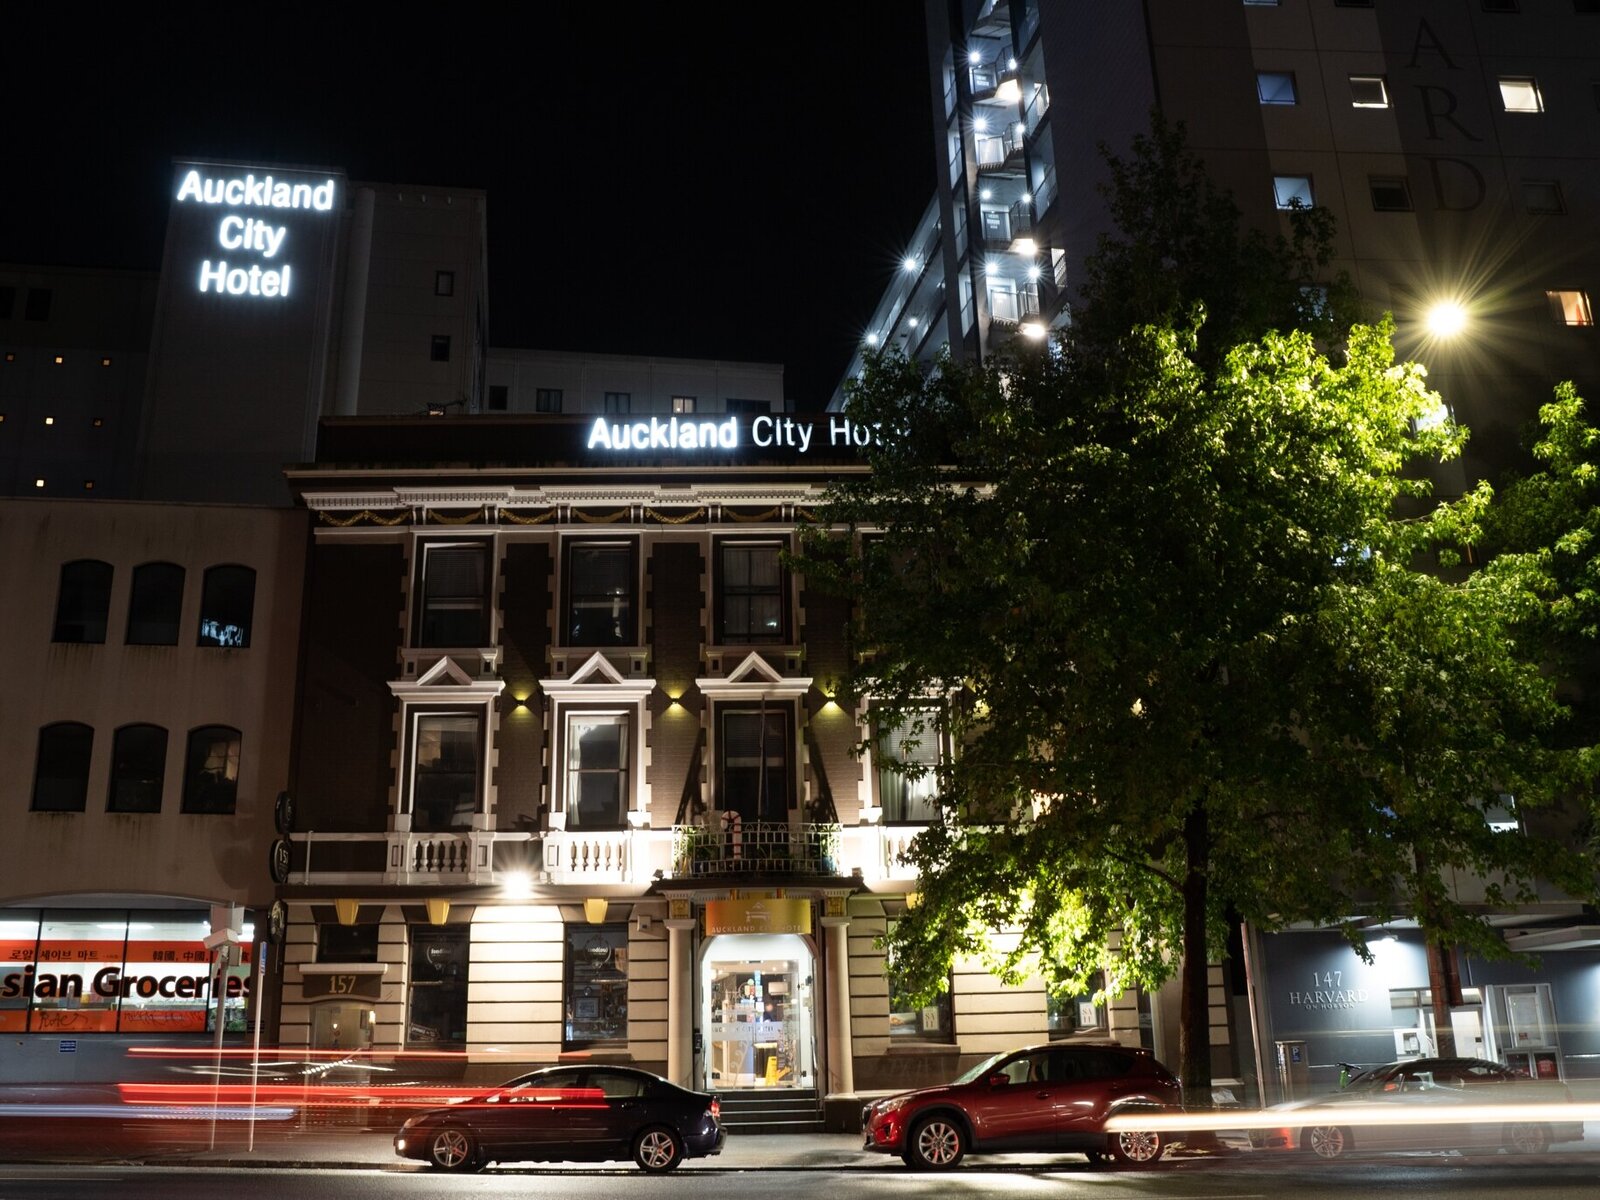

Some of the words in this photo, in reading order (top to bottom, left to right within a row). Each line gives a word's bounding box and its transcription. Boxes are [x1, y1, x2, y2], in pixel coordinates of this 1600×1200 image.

[177, 170, 335, 211] Auckland
[219, 215, 287, 258] City
[199, 259, 291, 297] Hotel
[587, 416, 738, 449] Auckland
[752, 416, 813, 452] City
[829, 416, 911, 447] Hot
[711, 925, 755, 933] AUCKLAND
[77, 949, 98, 960] 마트
[328, 975, 357, 993] 157
[1313, 970, 1342, 988] 147
[1288, 989, 1369, 1005] HARVARD
